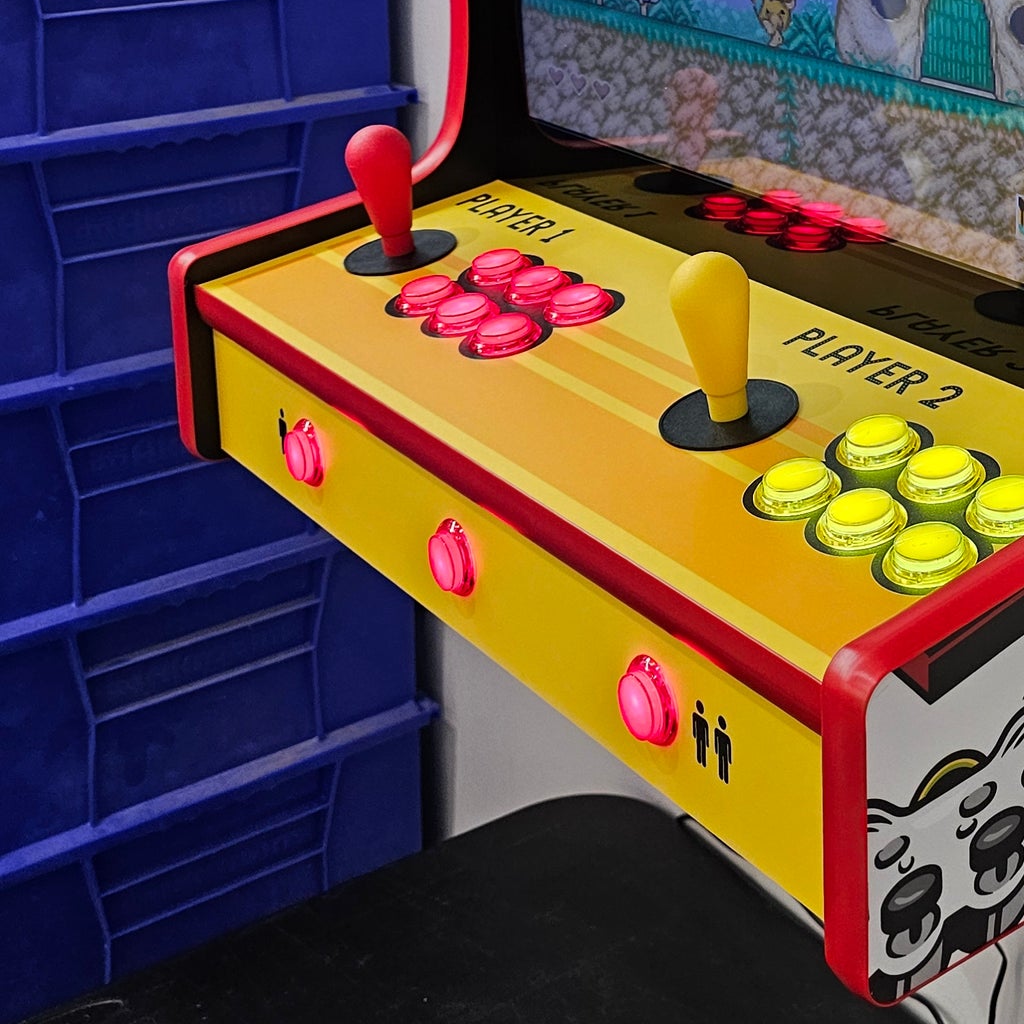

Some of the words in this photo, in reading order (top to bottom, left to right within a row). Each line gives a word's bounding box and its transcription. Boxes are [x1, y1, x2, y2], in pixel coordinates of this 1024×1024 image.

[456, 193, 556, 236] PLAYER
[539, 228, 576, 243] 1
[782, 327, 929, 396] PLAYER
[918, 385, 964, 410] 2
